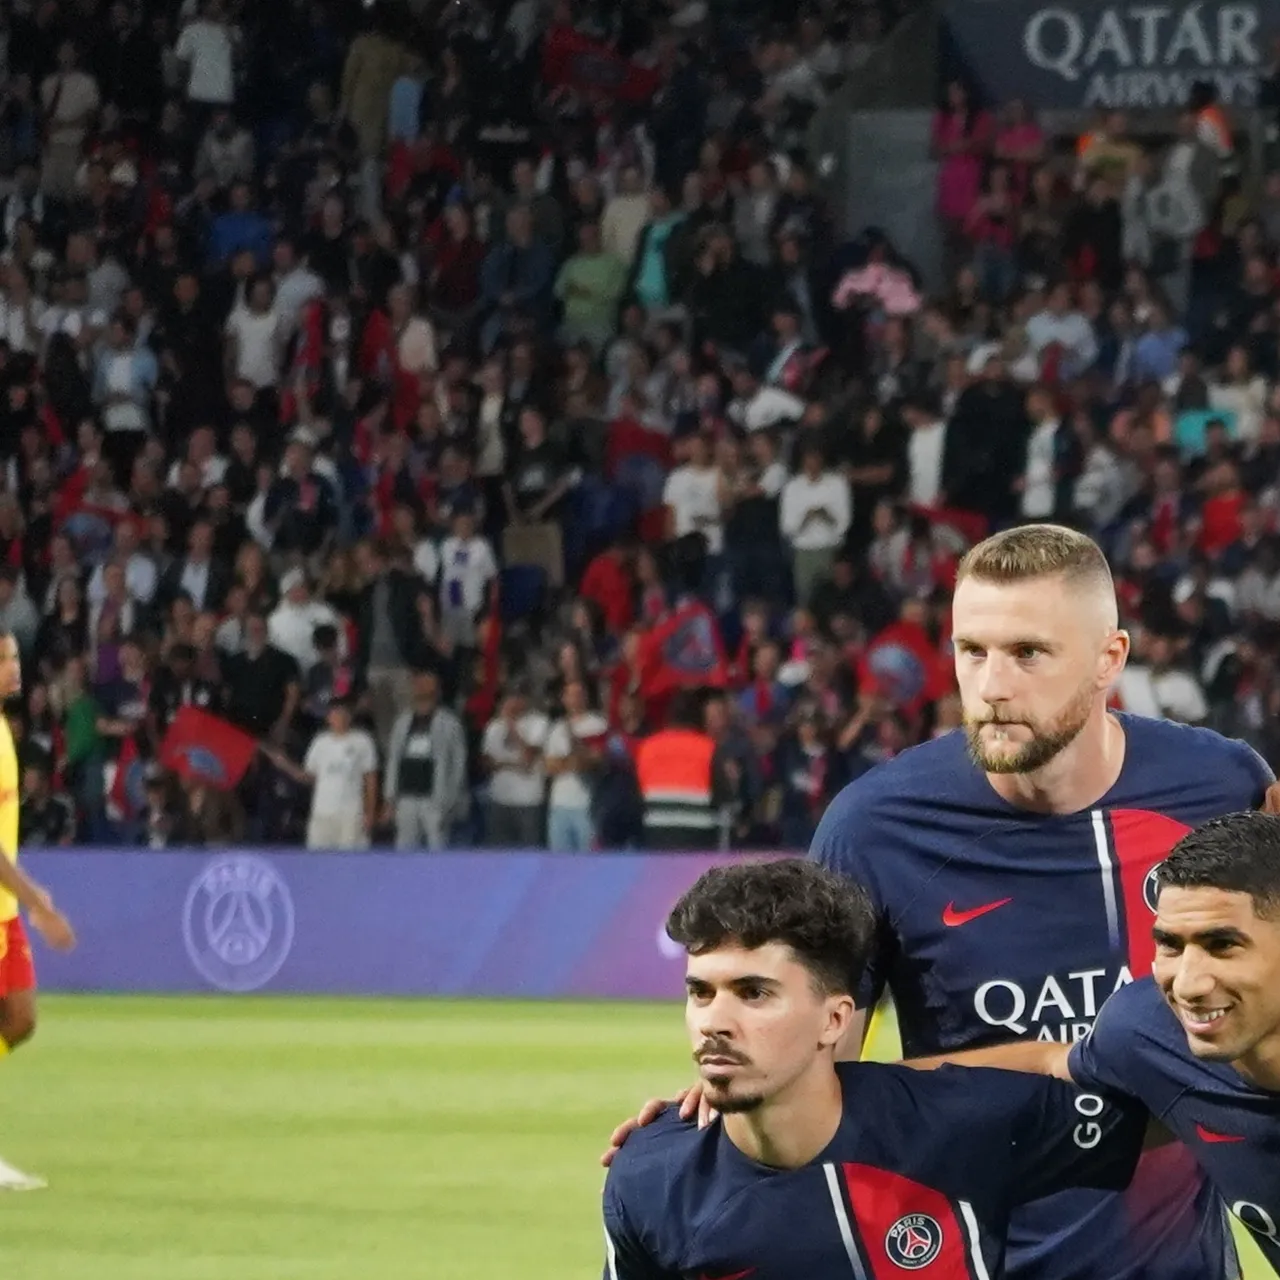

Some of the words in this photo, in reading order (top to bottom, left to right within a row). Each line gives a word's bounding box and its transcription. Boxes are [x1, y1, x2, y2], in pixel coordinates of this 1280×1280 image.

[1024, 3, 1260, 81] QATAR
[973, 966, 1135, 1035] QAT
[890, 1216, 925, 1239] PARIS
